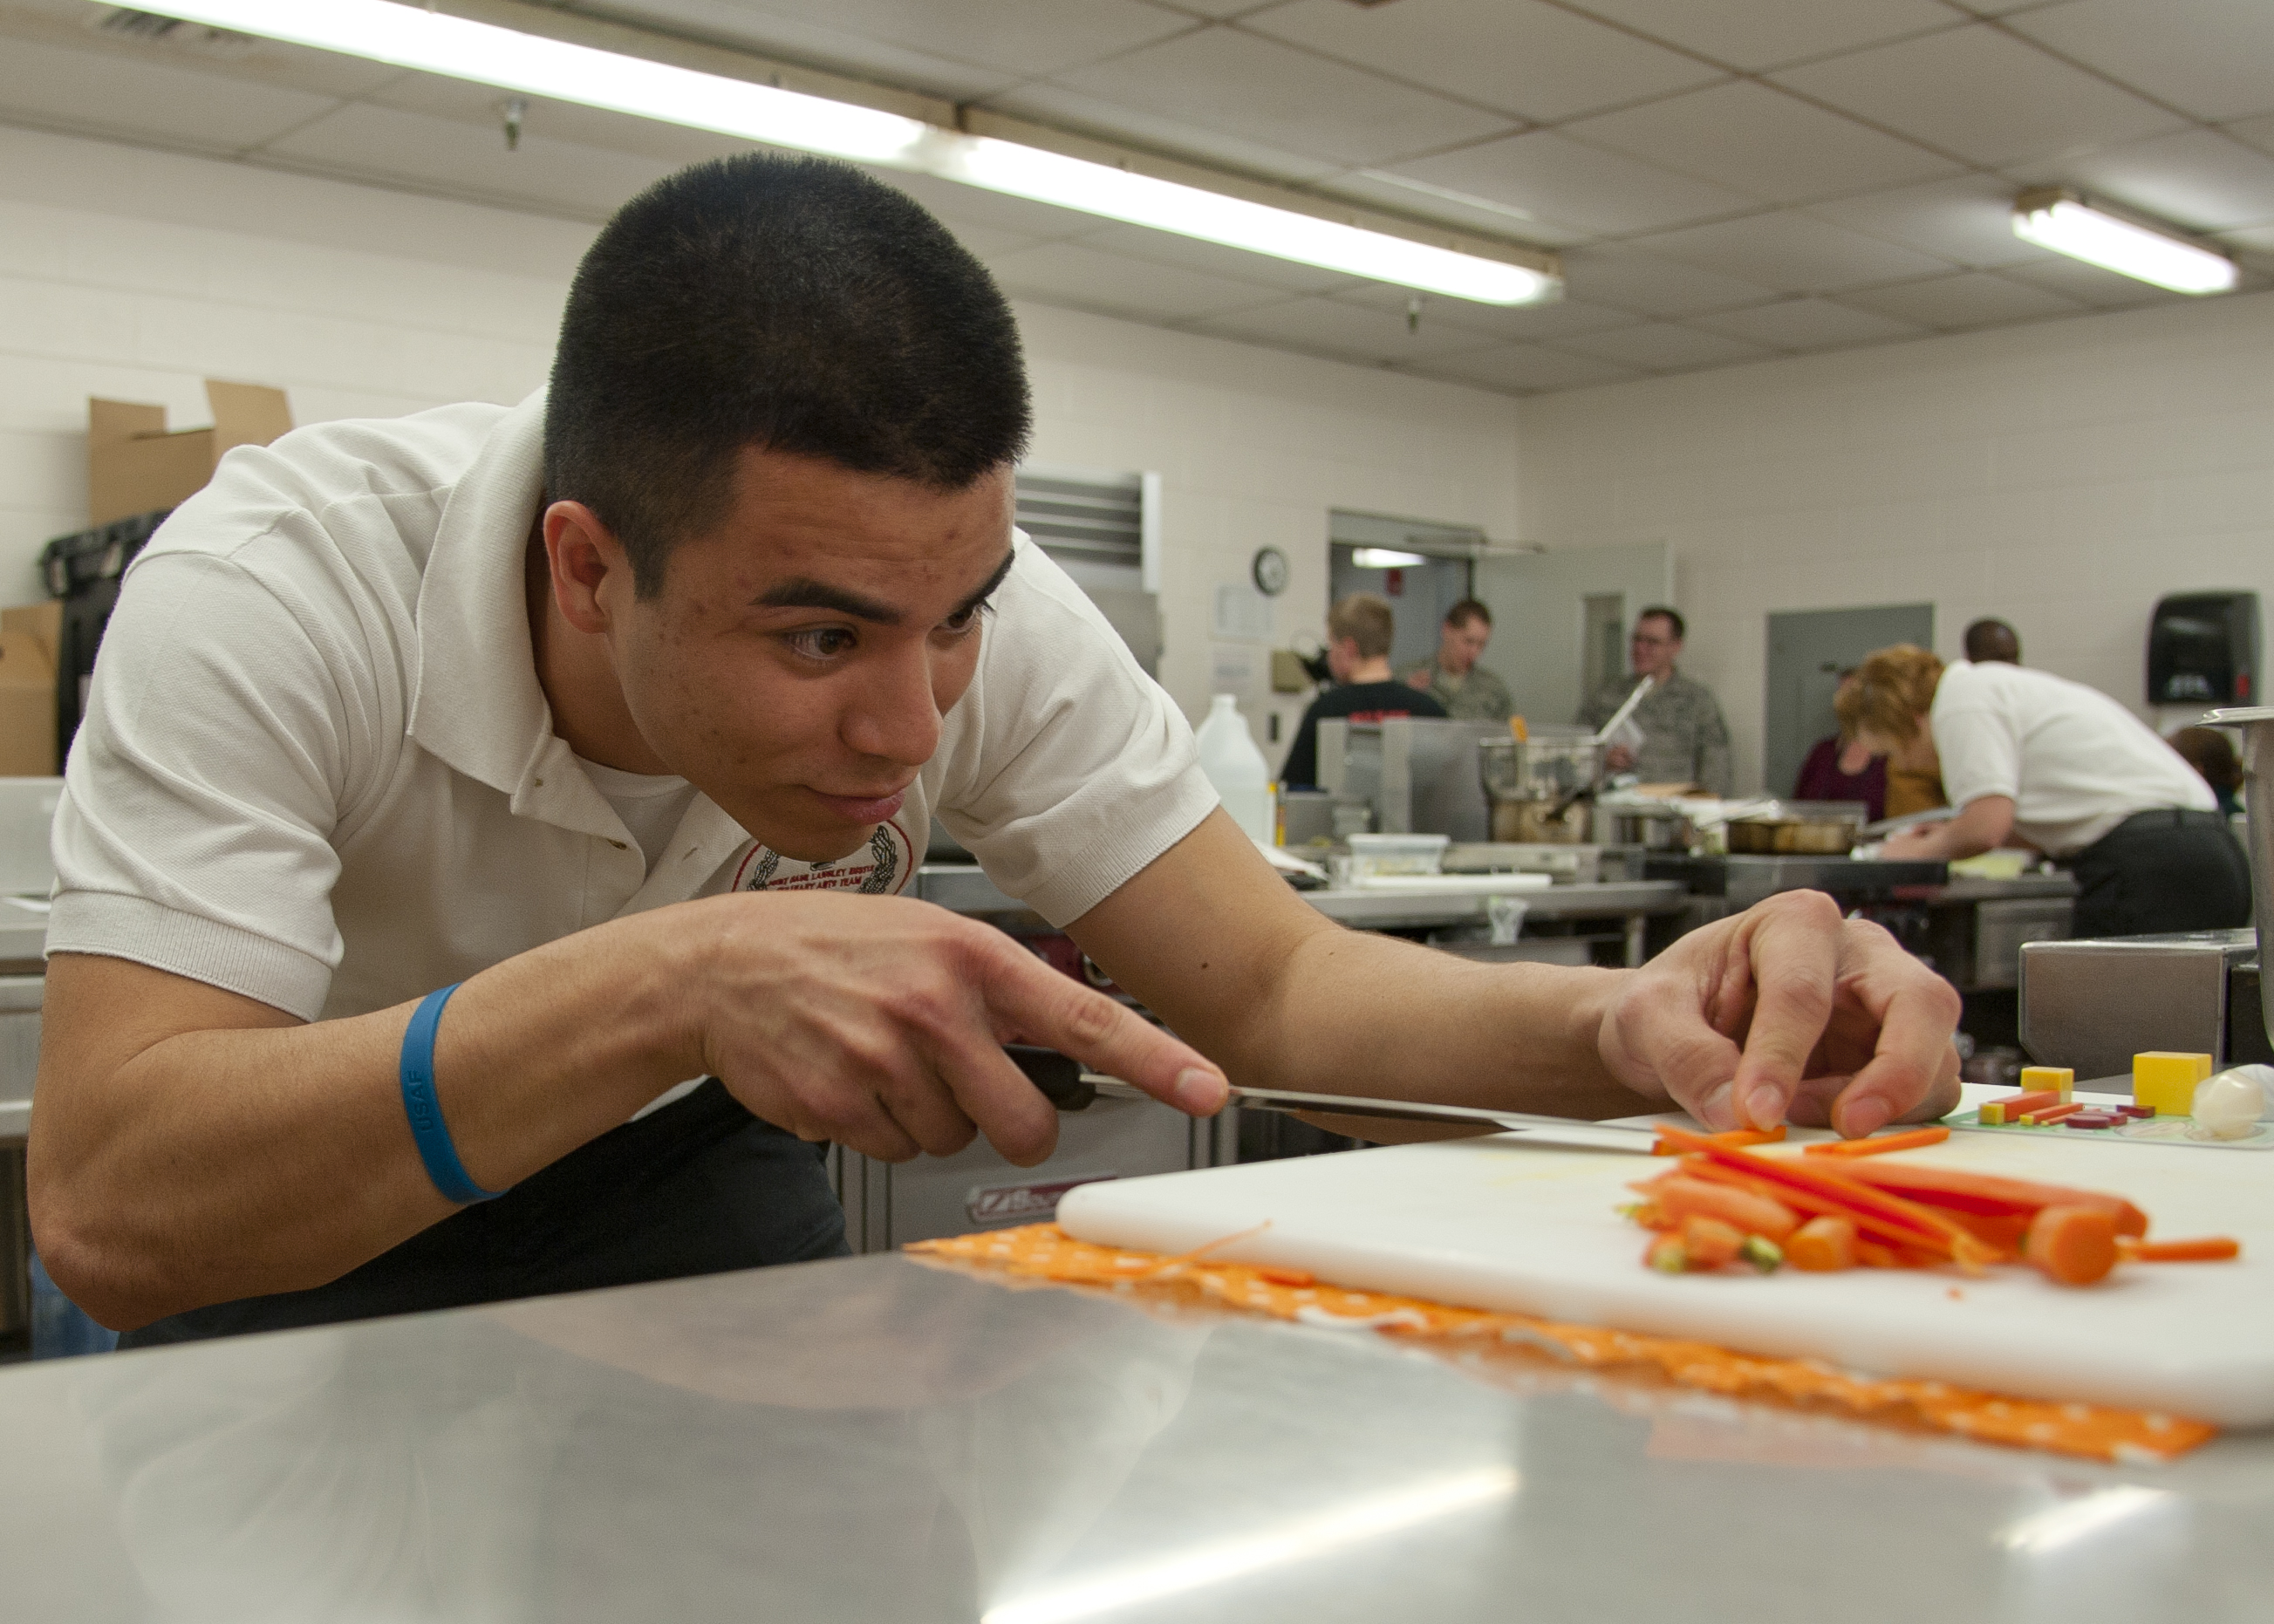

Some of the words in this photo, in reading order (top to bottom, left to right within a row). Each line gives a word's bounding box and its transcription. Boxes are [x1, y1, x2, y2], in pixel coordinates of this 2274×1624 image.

[811, 868, 846, 880] LANGLEY
[816, 879, 837, 889] ARTS
[840, 876, 863, 887] TEAM
[406, 1069, 435, 1134] USAF
